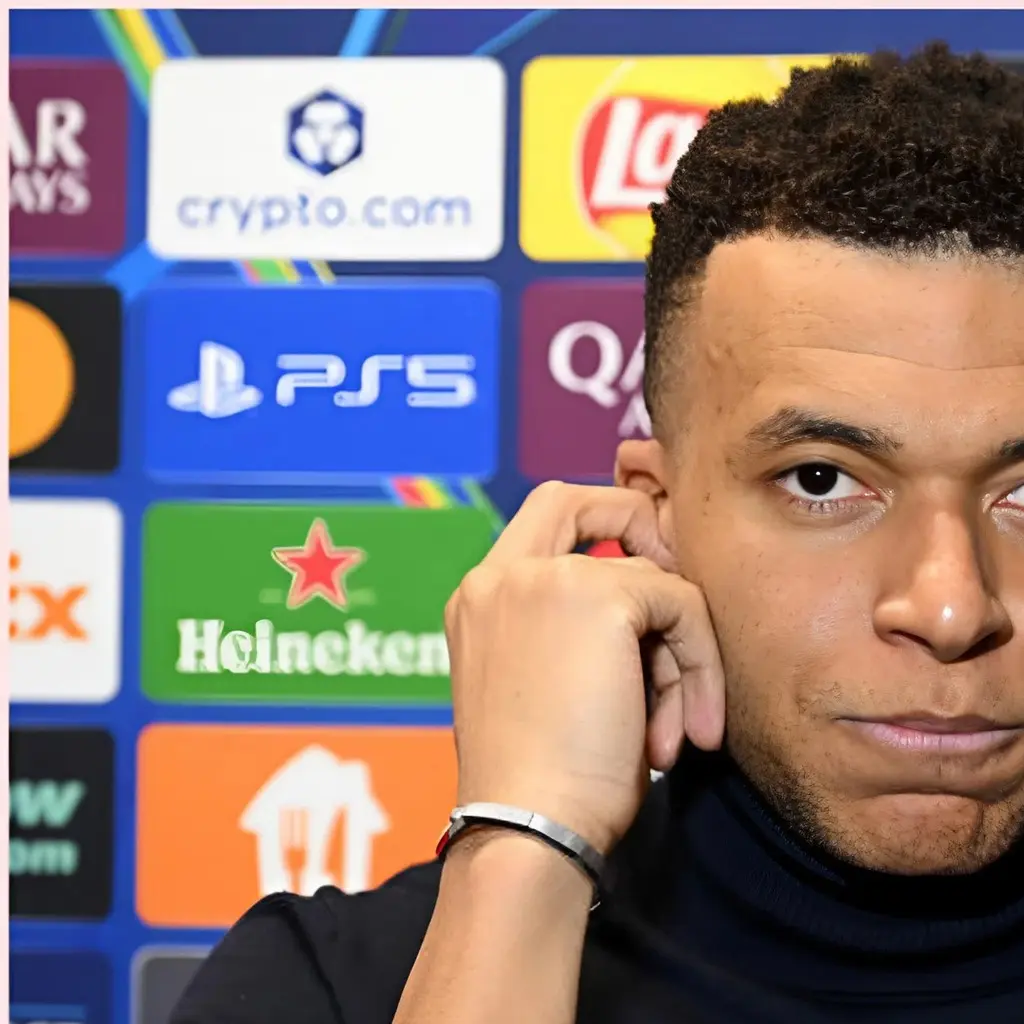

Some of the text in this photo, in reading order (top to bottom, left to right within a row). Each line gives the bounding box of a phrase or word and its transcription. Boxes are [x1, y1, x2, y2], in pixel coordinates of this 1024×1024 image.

[176, 194, 473, 234] crypto.com
[276, 354, 477, 408] PS5
[175, 618, 450, 676] Heineken
